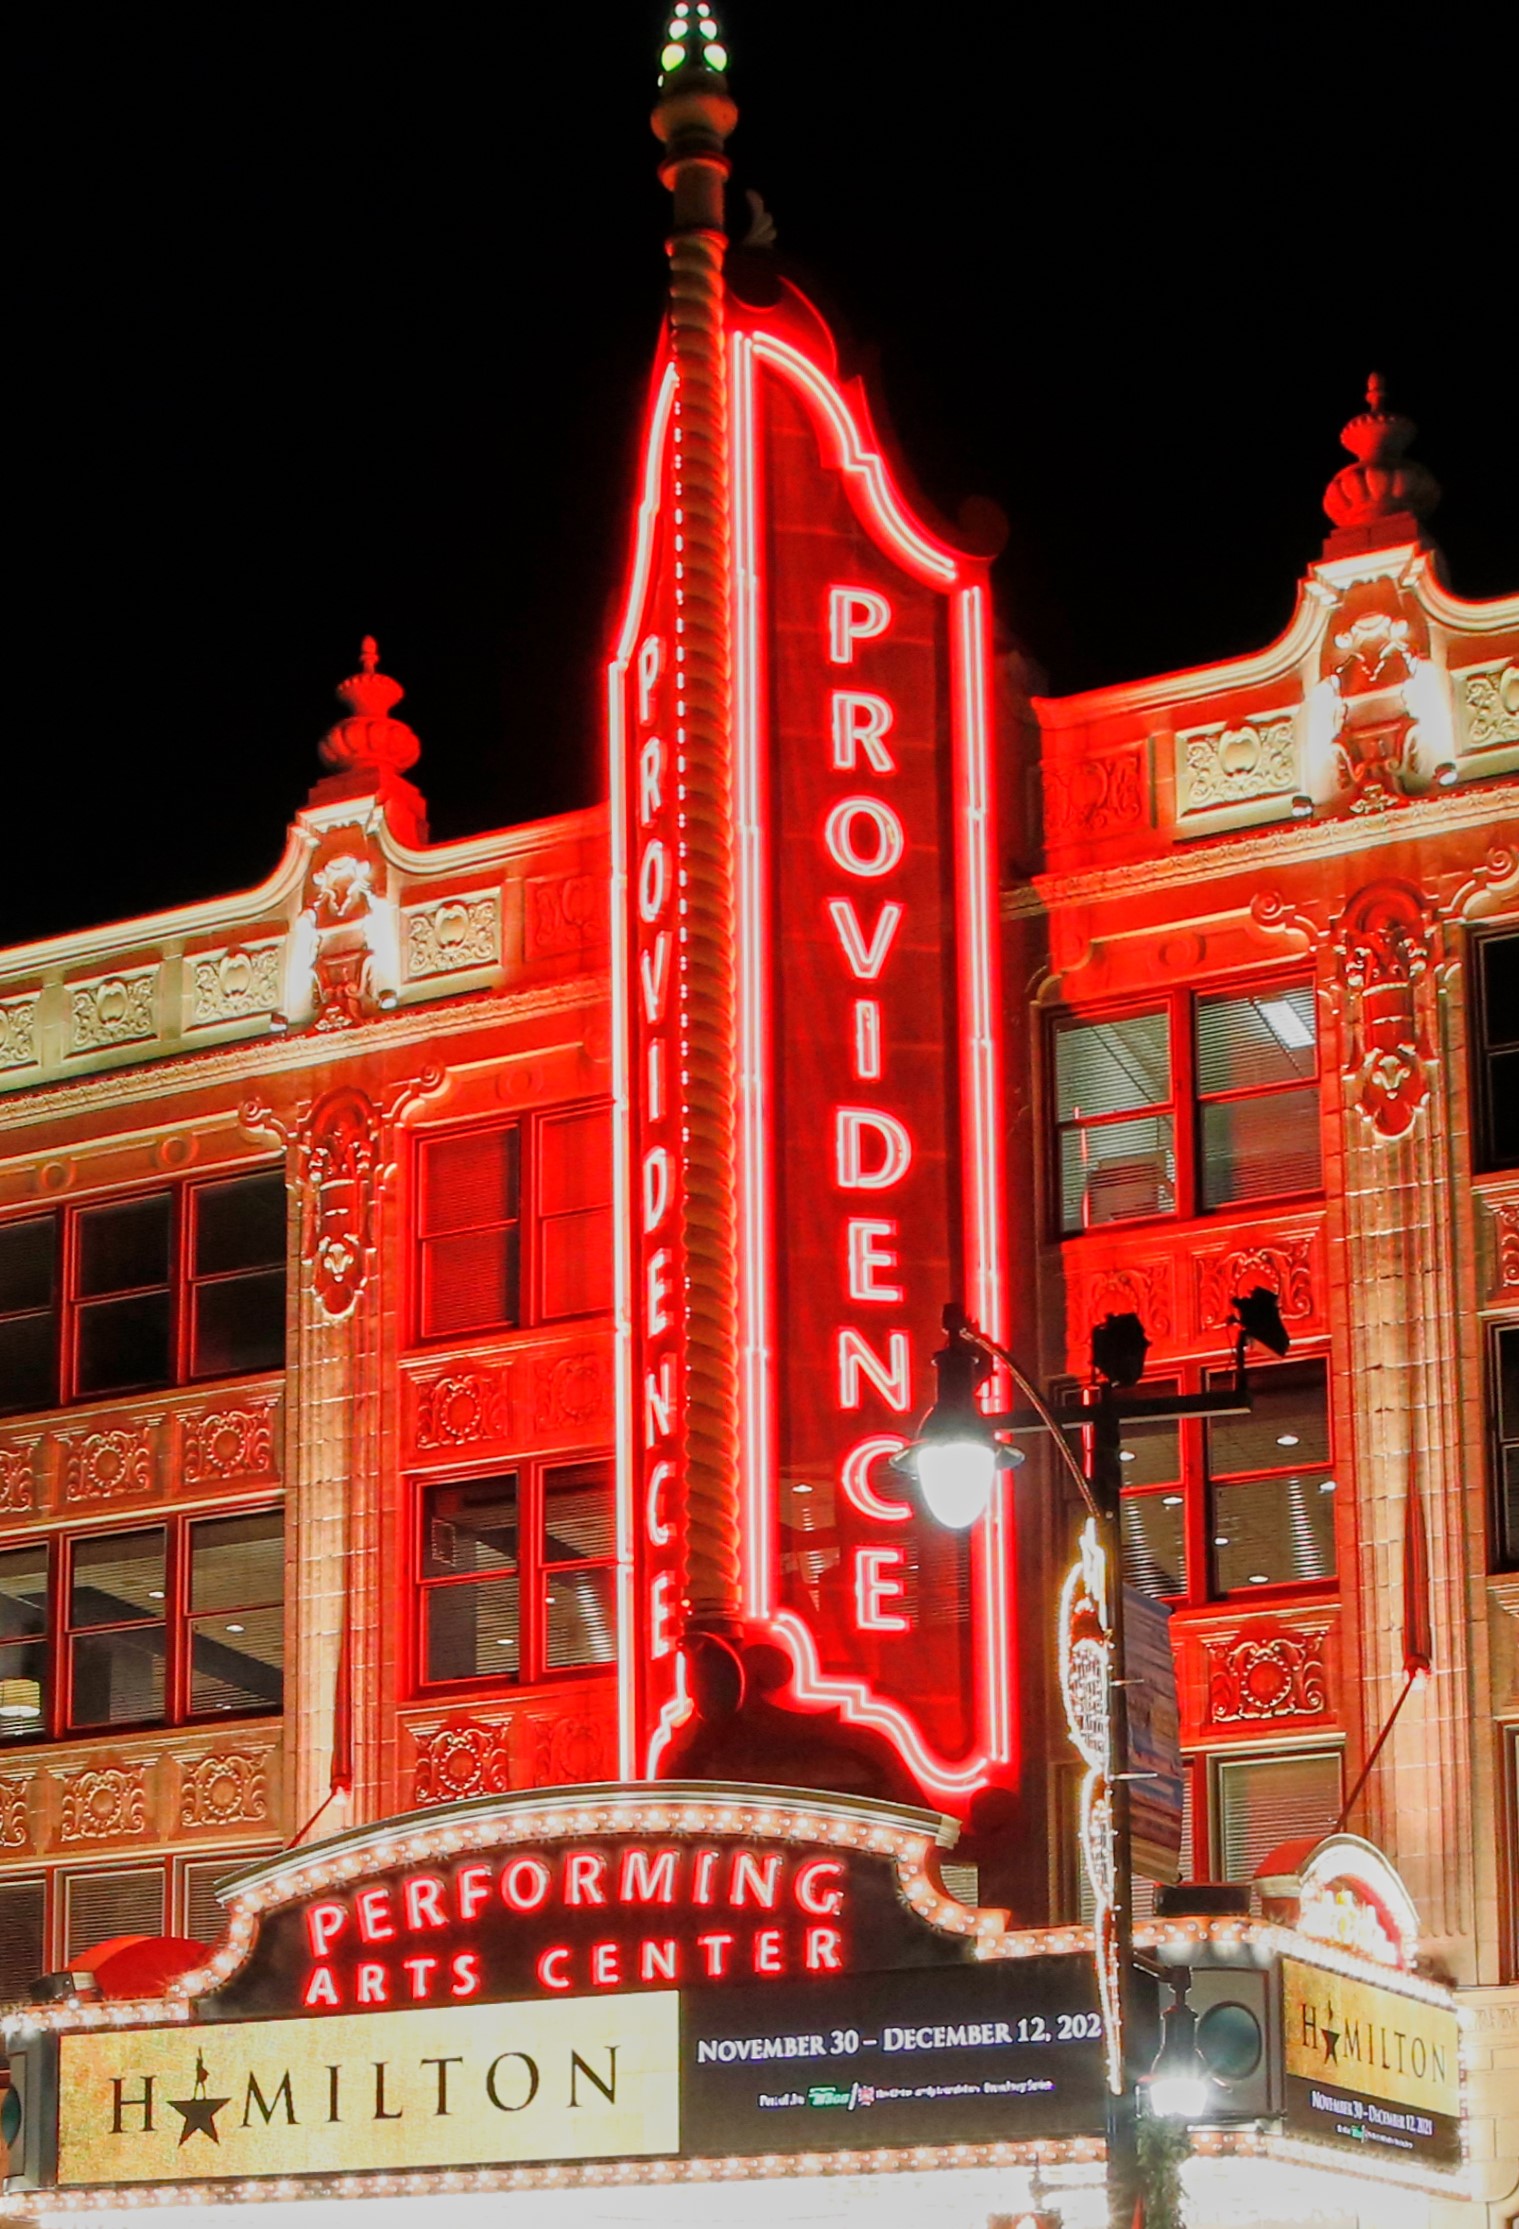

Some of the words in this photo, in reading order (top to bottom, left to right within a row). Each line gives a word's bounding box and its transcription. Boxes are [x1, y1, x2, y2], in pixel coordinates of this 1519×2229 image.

[638, 634, 676, 1660] PROVIDENCE
[825, 584, 912, 1631] PROVIDENCE
[307, 1851, 844, 1957] PERFORMING
[305, 1954, 479, 2005] ARTS
[538, 1927, 842, 1988] CENTER
[697, 2035, 827, 2063] NOVEMBER
[829, 2029, 859, 2054] 30
[883, 2023, 1012, 2051] DECEMBER
[1017, 2016, 1051, 2042] 12,
[1056, 2013, 1102, 2039] 202
